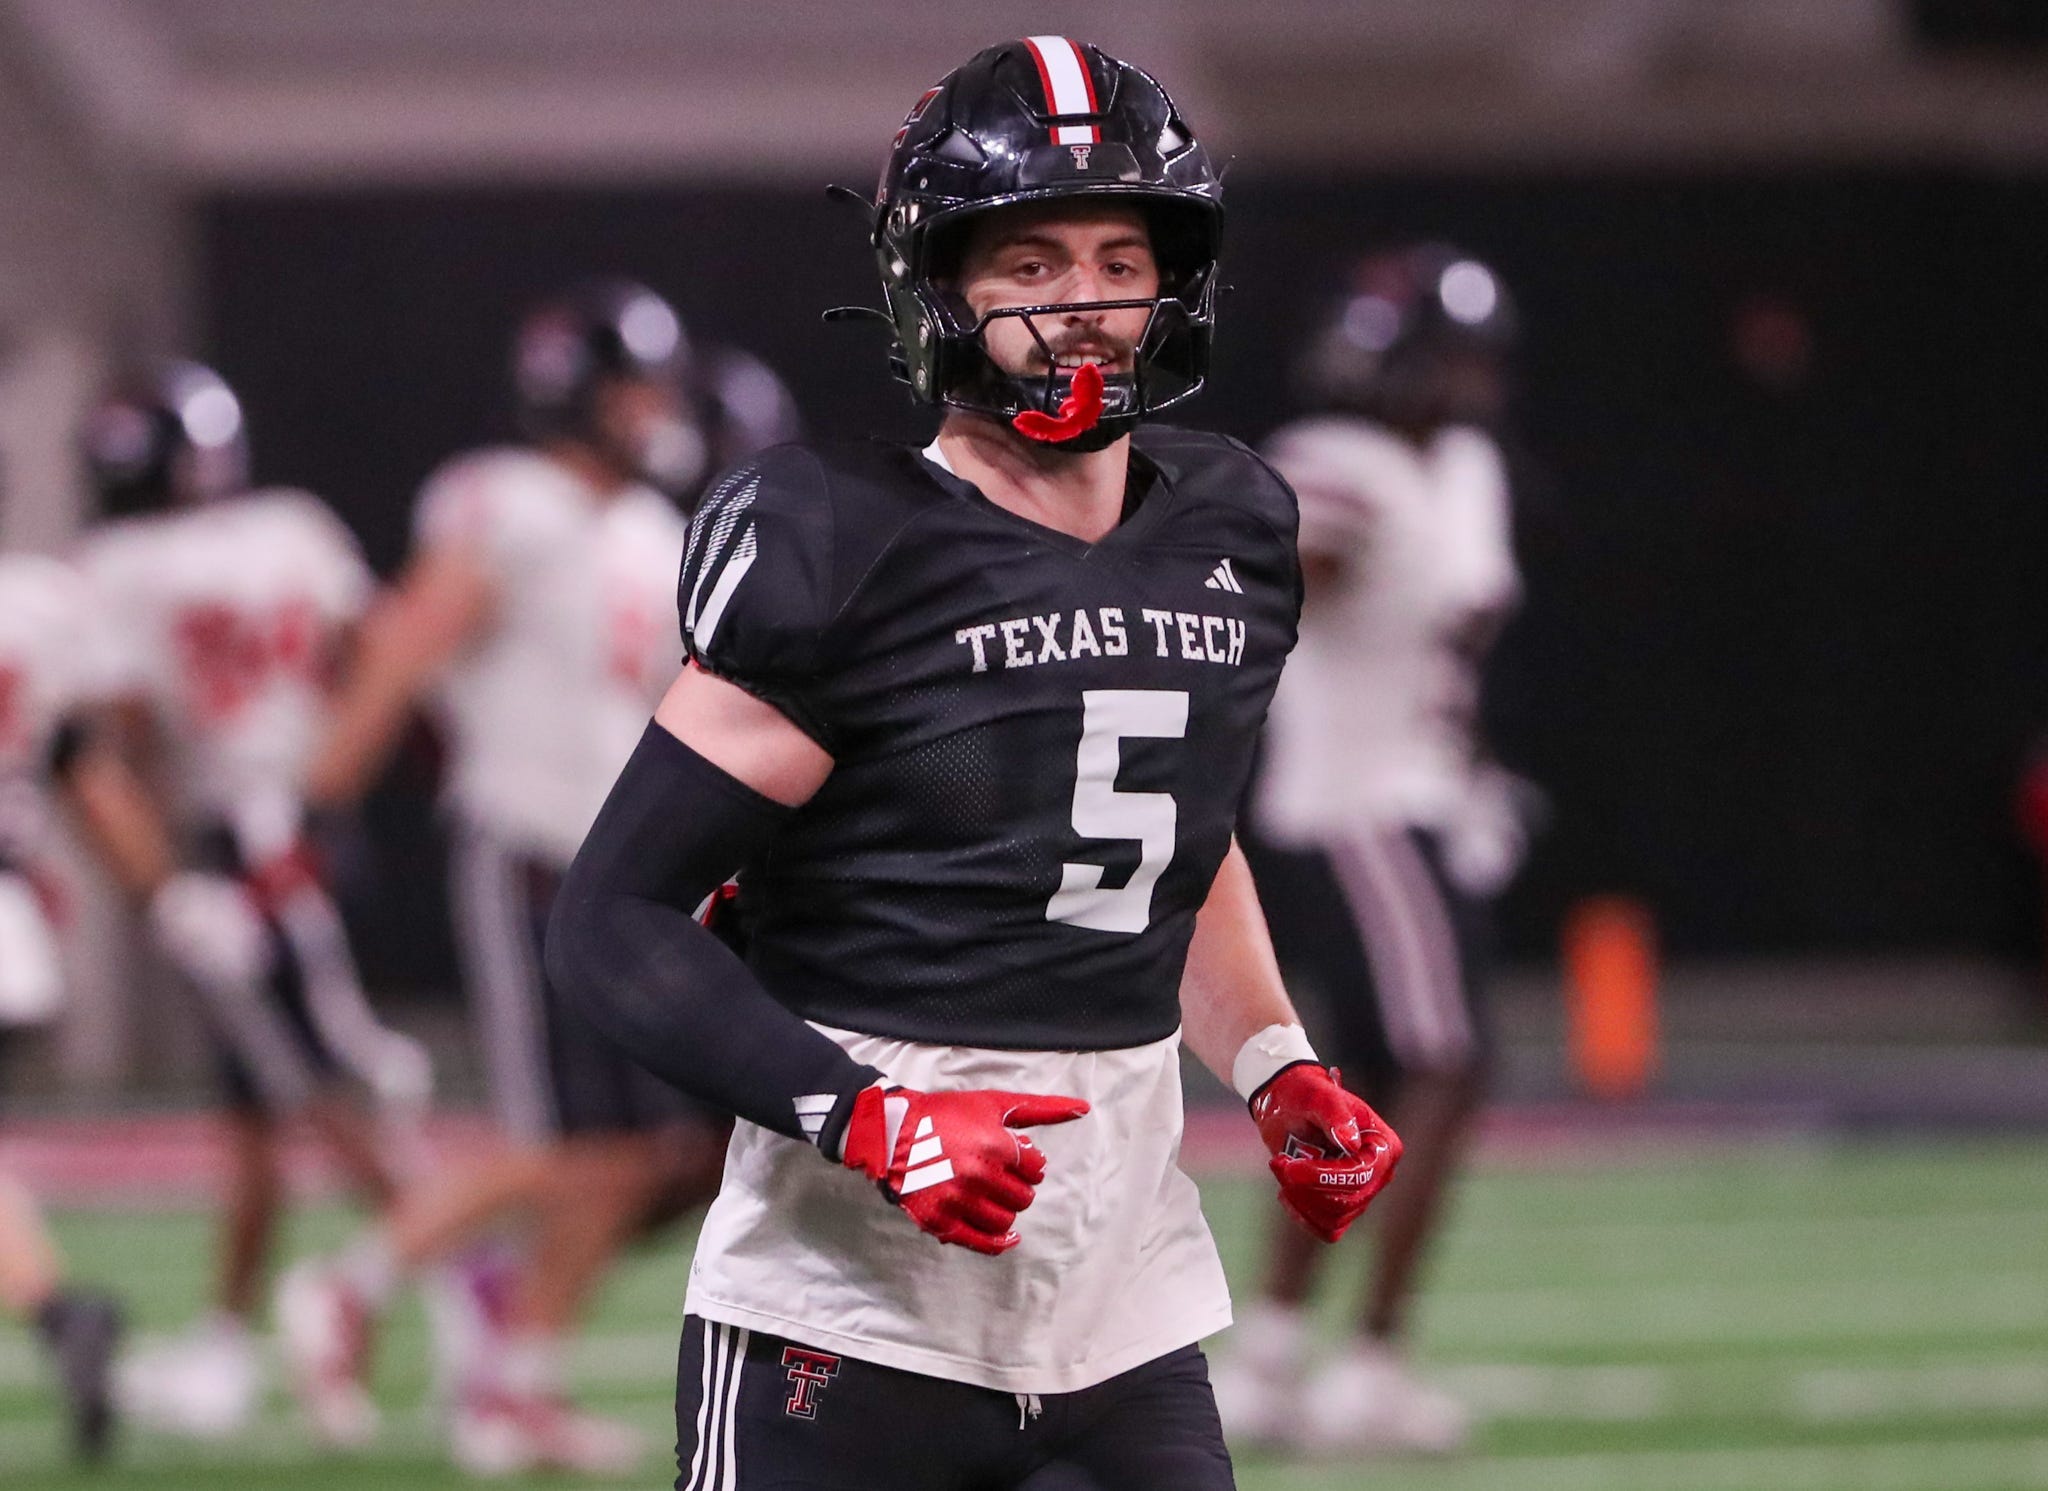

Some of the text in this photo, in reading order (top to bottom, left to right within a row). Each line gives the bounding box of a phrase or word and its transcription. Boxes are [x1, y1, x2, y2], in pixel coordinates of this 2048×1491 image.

[955, 607, 1246, 672] TEXAS TECH
[1045, 689, 1190, 934] 5
[1319, 1167, 1374, 1185] ADIZERO
